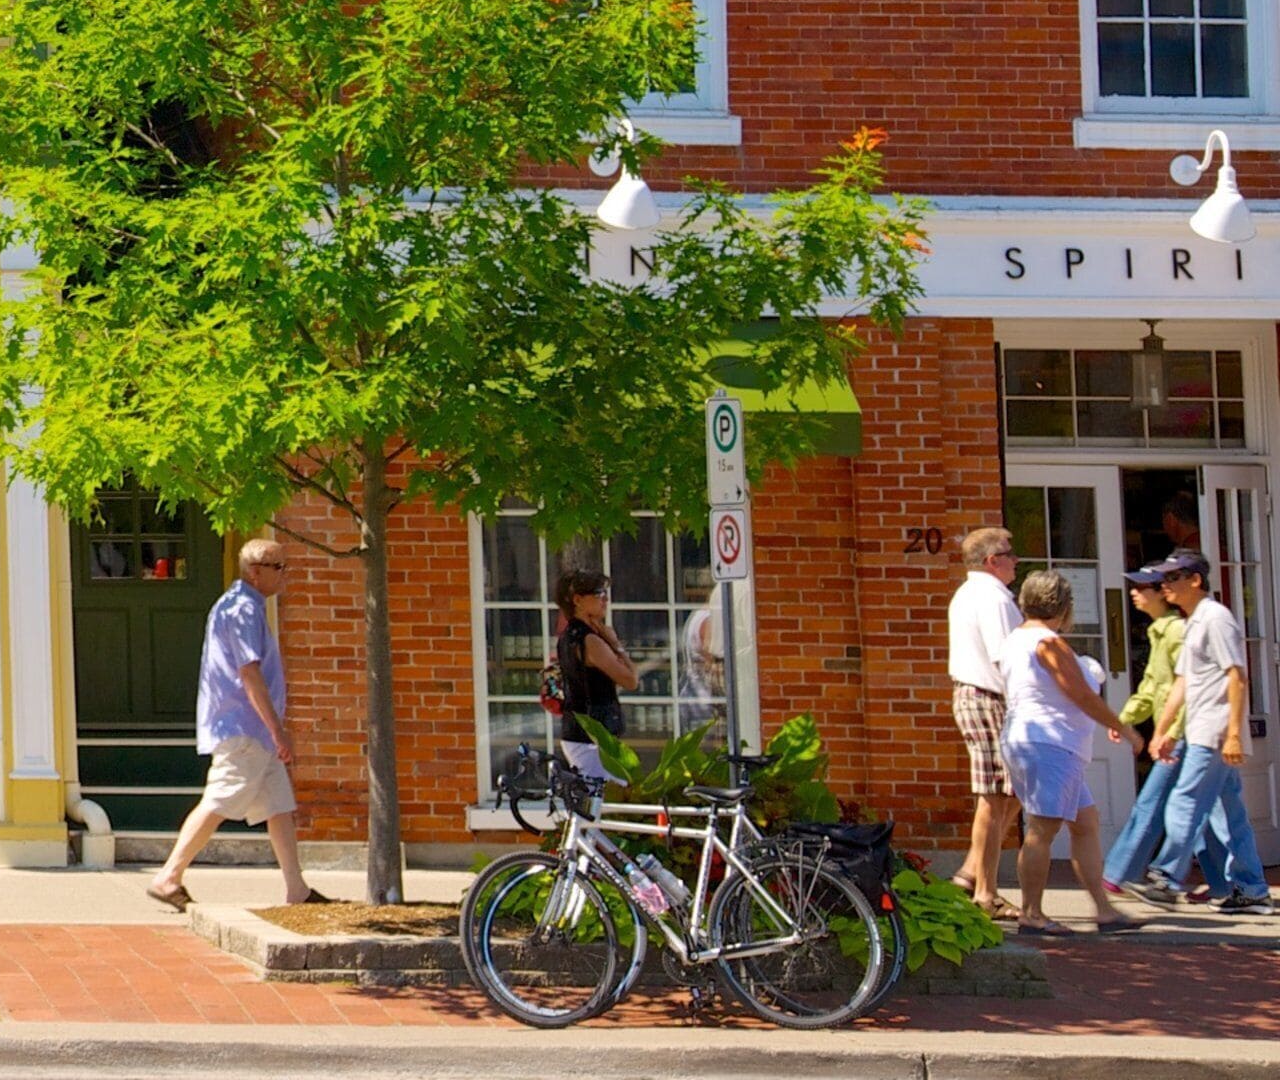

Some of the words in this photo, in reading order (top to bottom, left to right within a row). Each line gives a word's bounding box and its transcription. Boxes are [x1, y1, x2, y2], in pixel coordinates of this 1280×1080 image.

[1004, 247, 1244, 280] SPIRI
[720, 416, 730, 442] P
[903, 527, 943, 555] 20
